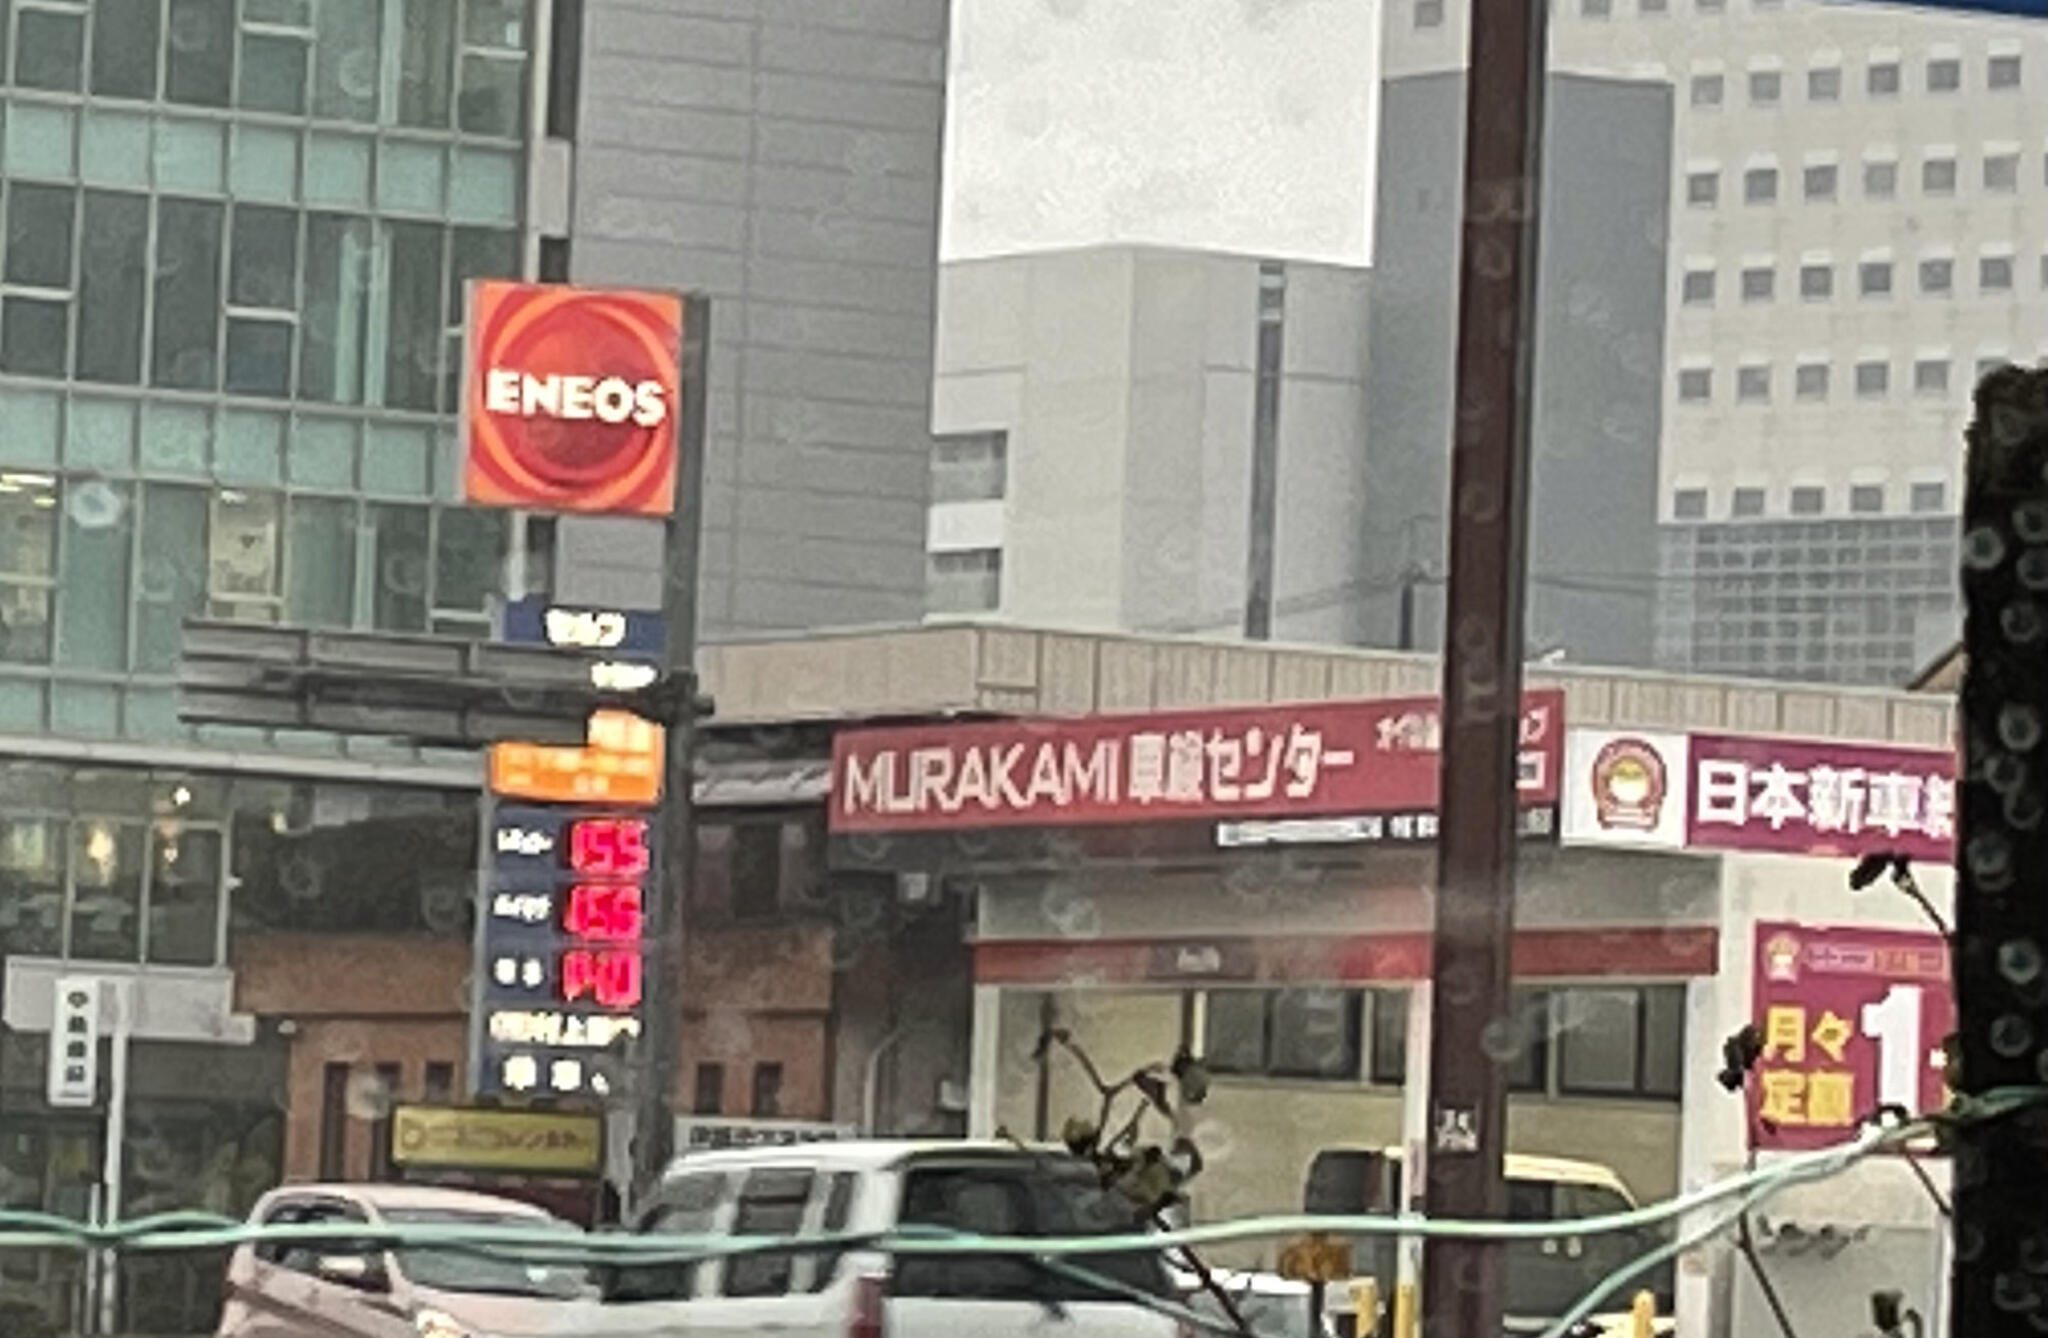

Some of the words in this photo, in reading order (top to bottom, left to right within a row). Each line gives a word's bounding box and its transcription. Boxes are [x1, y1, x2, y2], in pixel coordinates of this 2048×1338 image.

[486, 370, 666, 427] ENEOS
[843, 740, 1119, 814] MURAKAMI
[1763, 1006, 1853, 1062] 月々
